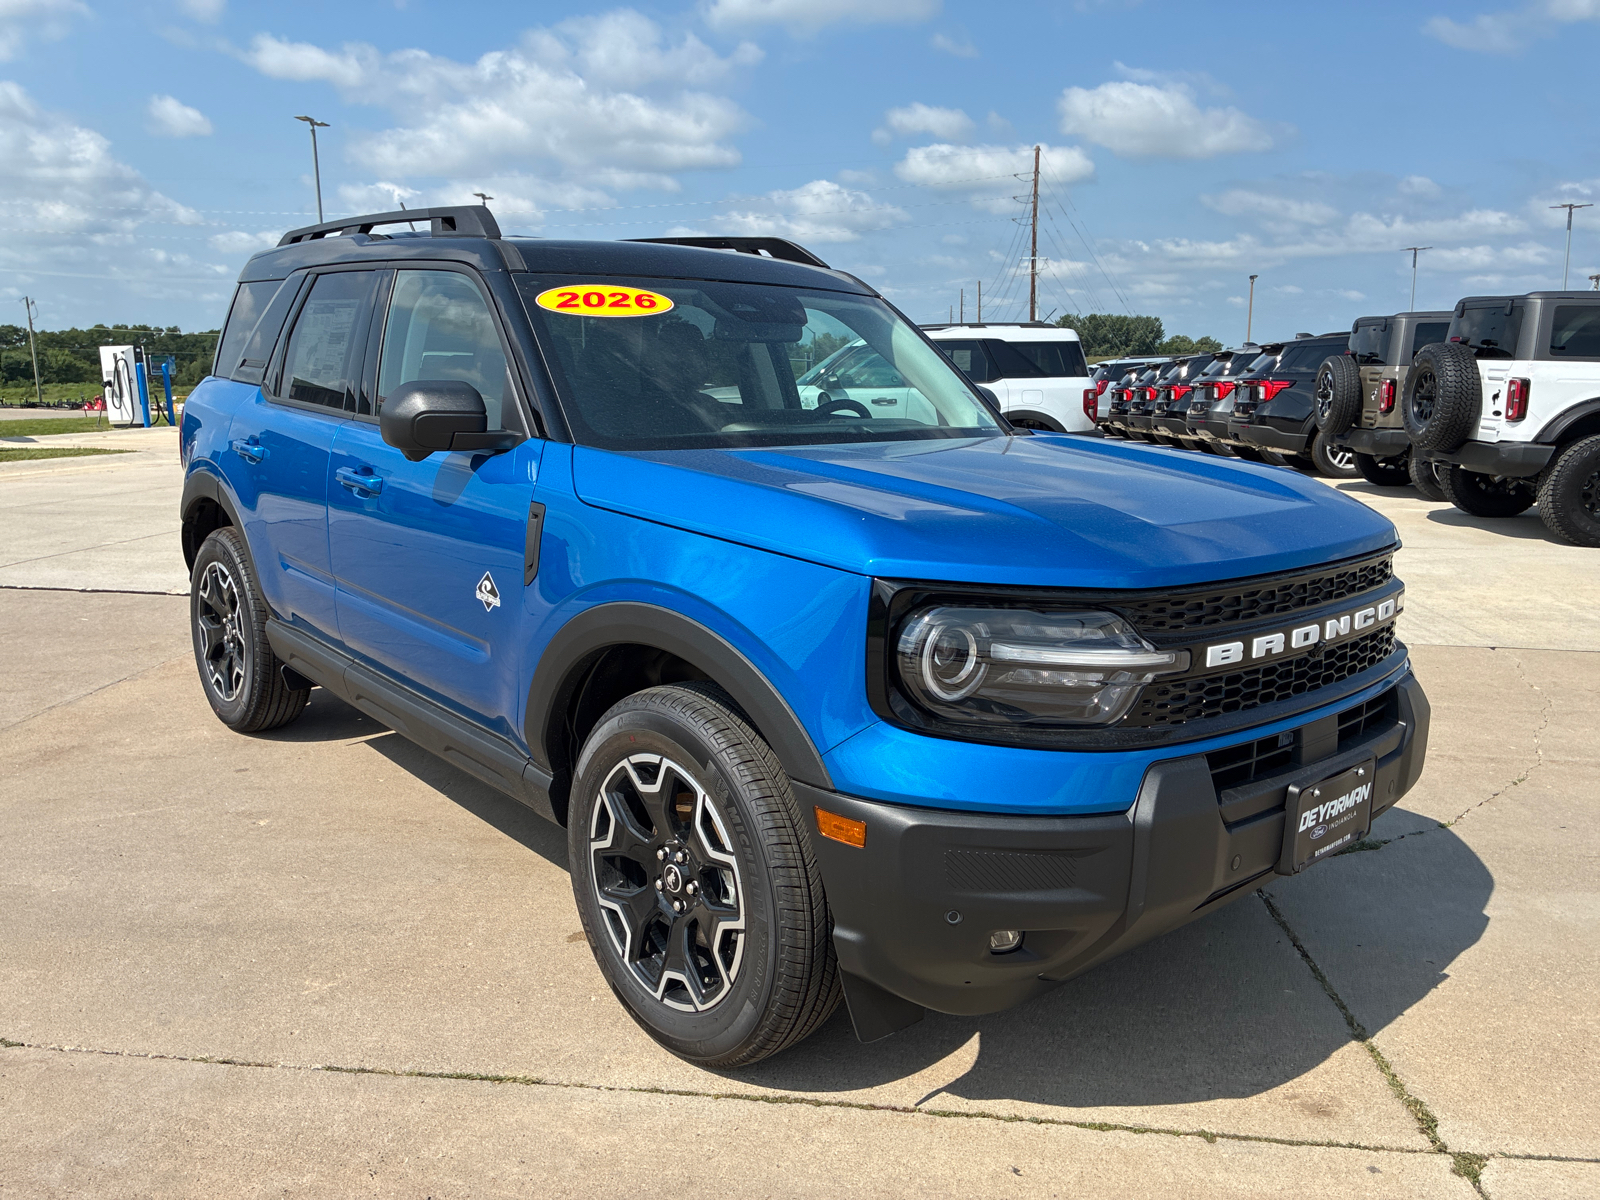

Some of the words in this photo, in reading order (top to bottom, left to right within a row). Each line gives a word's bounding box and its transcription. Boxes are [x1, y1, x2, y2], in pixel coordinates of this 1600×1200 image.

[556, 292, 658, 308] 2026
[1206, 599, 1395, 667] BRONCO
[1298, 782, 1372, 833] DEYARMAN
[1328, 810, 1357, 831] INDIANOLA
[727, 806, 765, 915] MICHELIN
